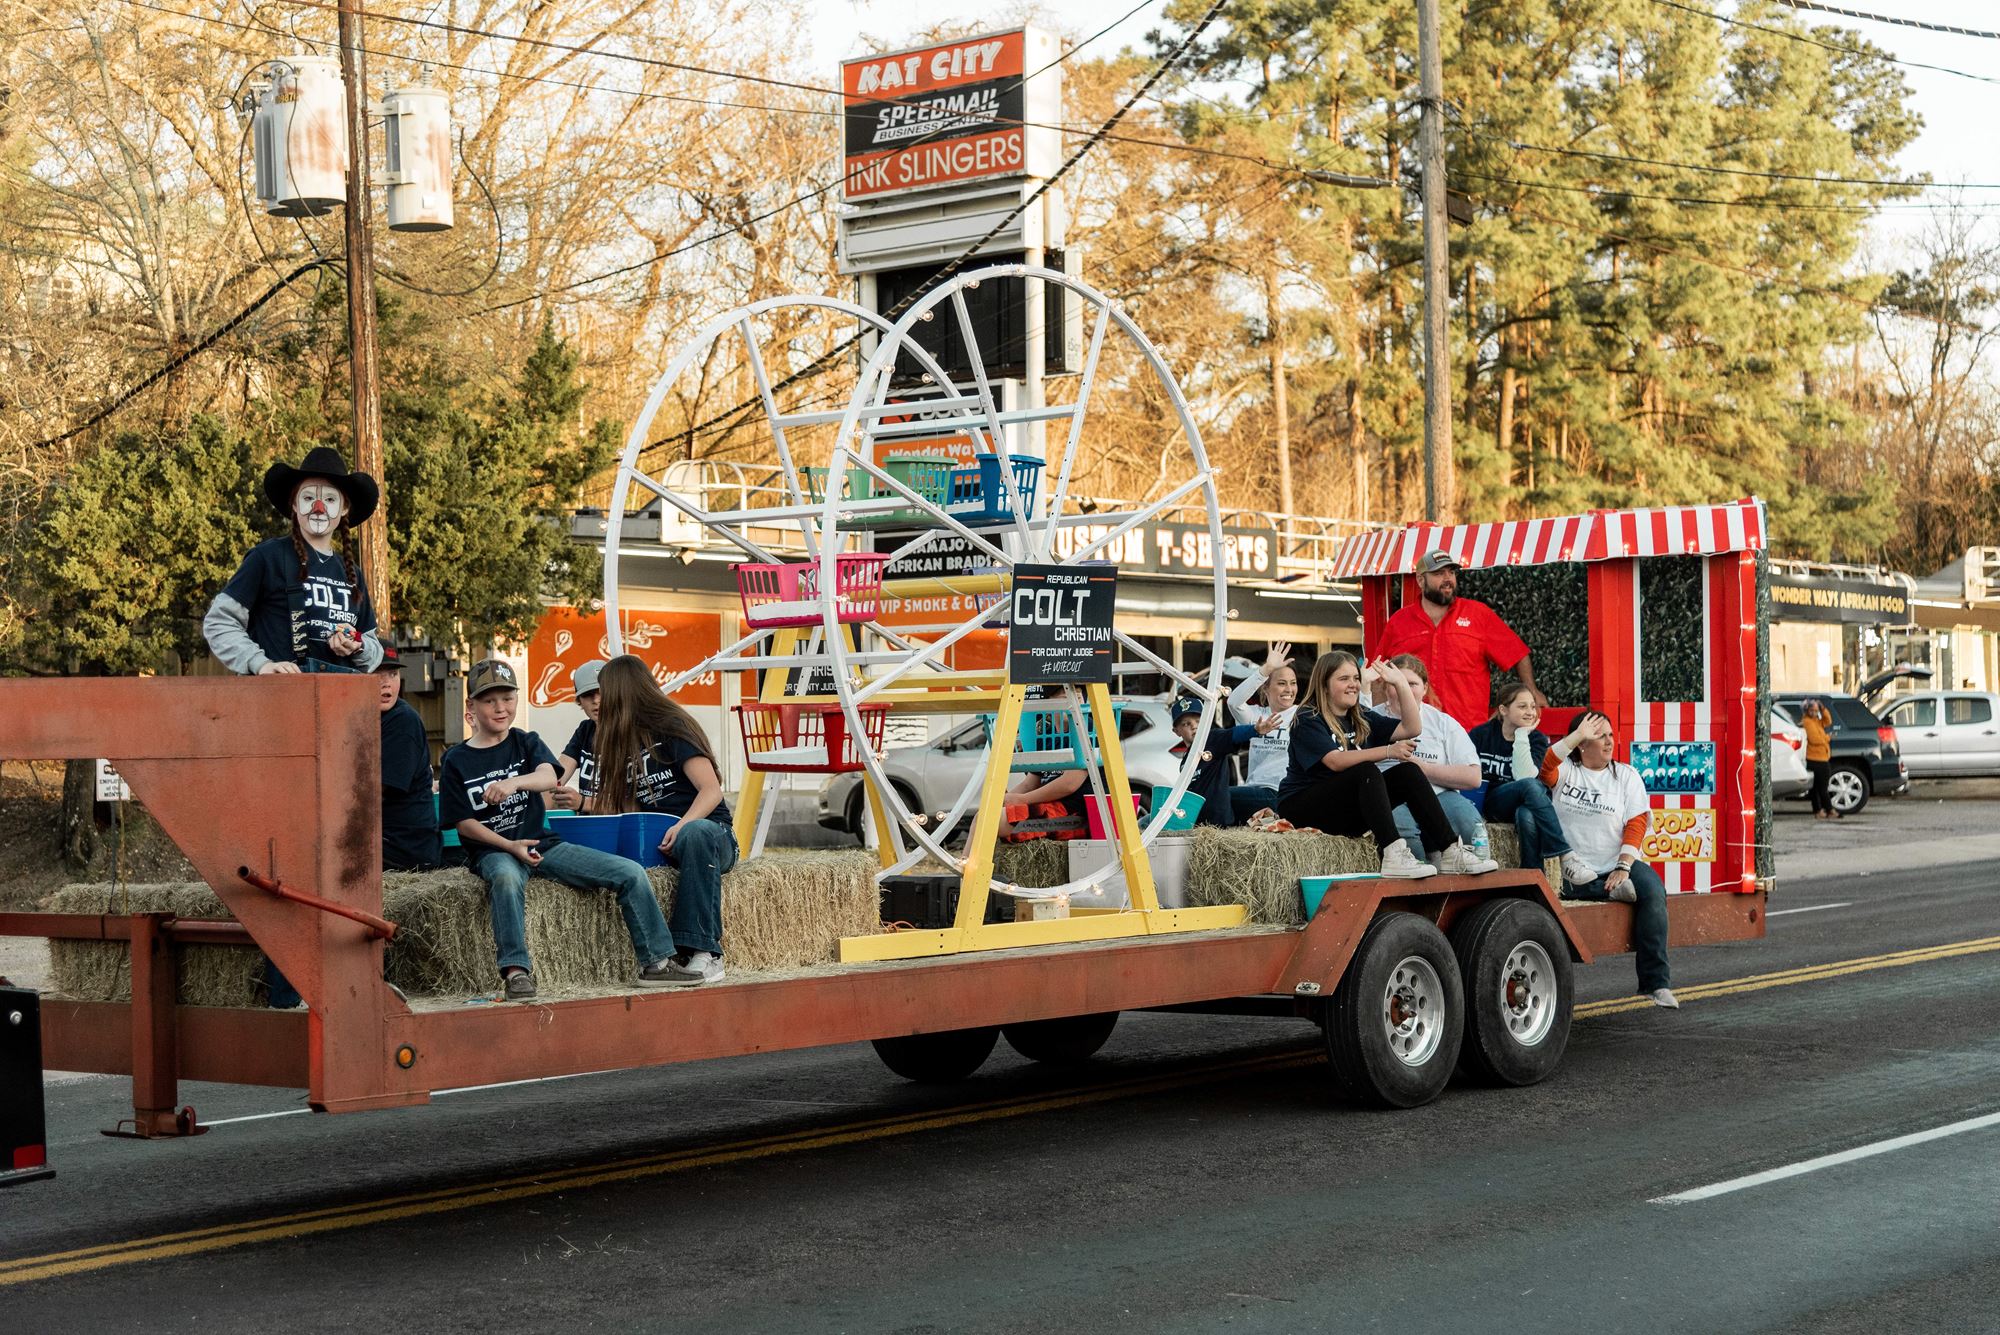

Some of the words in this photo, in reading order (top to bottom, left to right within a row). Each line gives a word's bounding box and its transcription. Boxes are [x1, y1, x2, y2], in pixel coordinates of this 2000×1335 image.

[857, 56, 922, 94] KAT
[930, 41, 1003, 81] CITY
[877, 88, 1000, 129] SPEEDMAIL
[879, 121, 939, 140] BUSINESS
[851, 158, 891, 192] INK
[899, 134, 1022, 183] SLINGERS
[948, 443, 976, 458] Wa
[906, 538, 974, 554] AMAJO'S
[1053, 525, 1145, 564] USTOM
[1156, 528, 1268, 573] T-SHRTS
[887, 558, 943, 573] AFRICAN
[946, 555, 992, 570] BRAIDS
[1046, 575, 1088, 584] REPUBLICAN
[880, 599, 901, 614] VIP
[904, 597, 948, 612] SMOKE
[951, 596, 960, 610] &
[1014, 588, 1091, 626] COLT
[1770, 585, 1812, 606] WONDER
[1840, 592, 1879, 611] AFRICAN
[1880, 595, 1905, 615] FOOD
[1055, 627, 1111, 641] CHRISTIAN
[1031, 647, 1045, 656] FOR
[1046, 647, 1072, 656] COUNTY
[1073, 647, 1093, 656] JUDGE
[1658, 746, 1689, 767] ICE
[1642, 768, 1705, 789] CREAM
[1562, 783, 1602, 803] COLT
[1653, 811, 1696, 834] POP
[1642, 834, 1702, 858] CORN
